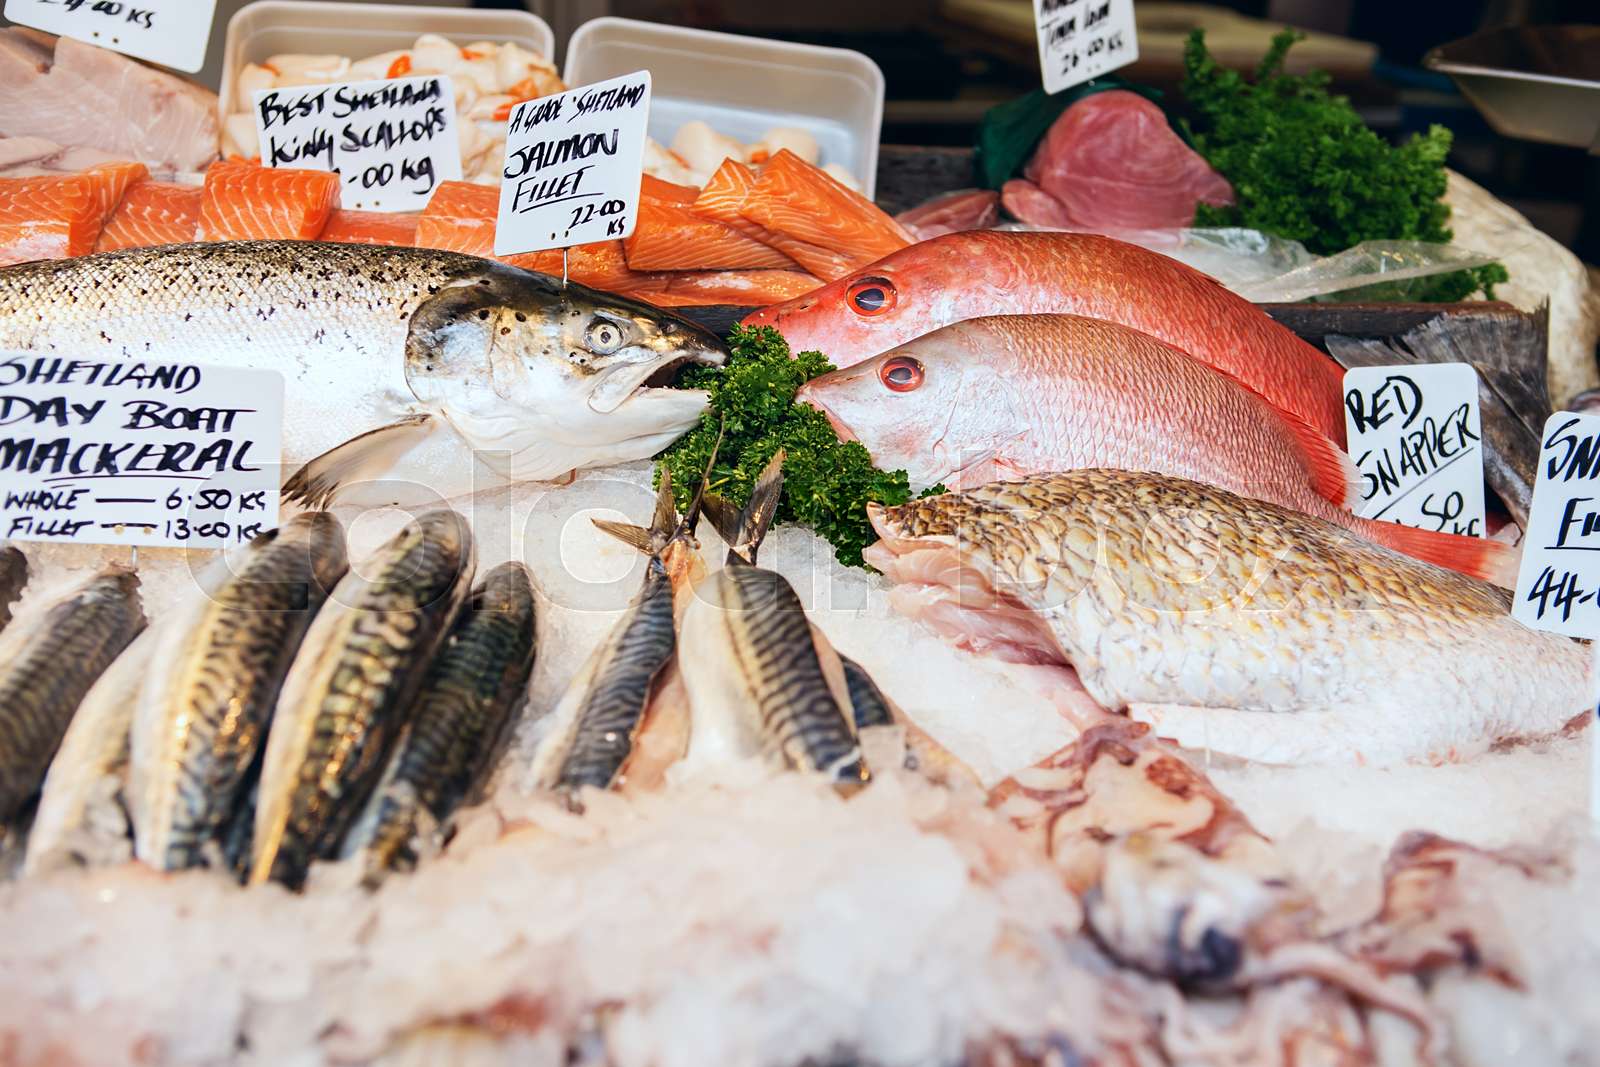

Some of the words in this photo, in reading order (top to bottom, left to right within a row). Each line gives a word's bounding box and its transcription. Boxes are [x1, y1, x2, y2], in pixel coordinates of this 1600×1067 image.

[259, 88, 329, 130] BEST
[509, 104, 526, 135] A
[503, 128, 620, 179] SALMON
[511, 164, 597, 213] FILLET
[0, 356, 202, 394] SHETLAND
[0, 395, 108, 427] DAY
[120, 400, 257, 434] BOAT
[1345, 375, 1424, 435] RED
[0, 437, 262, 476] MACKERAL
[1355, 402, 1481, 501] SNAPPER
[4, 488, 91, 511] WHOLE
